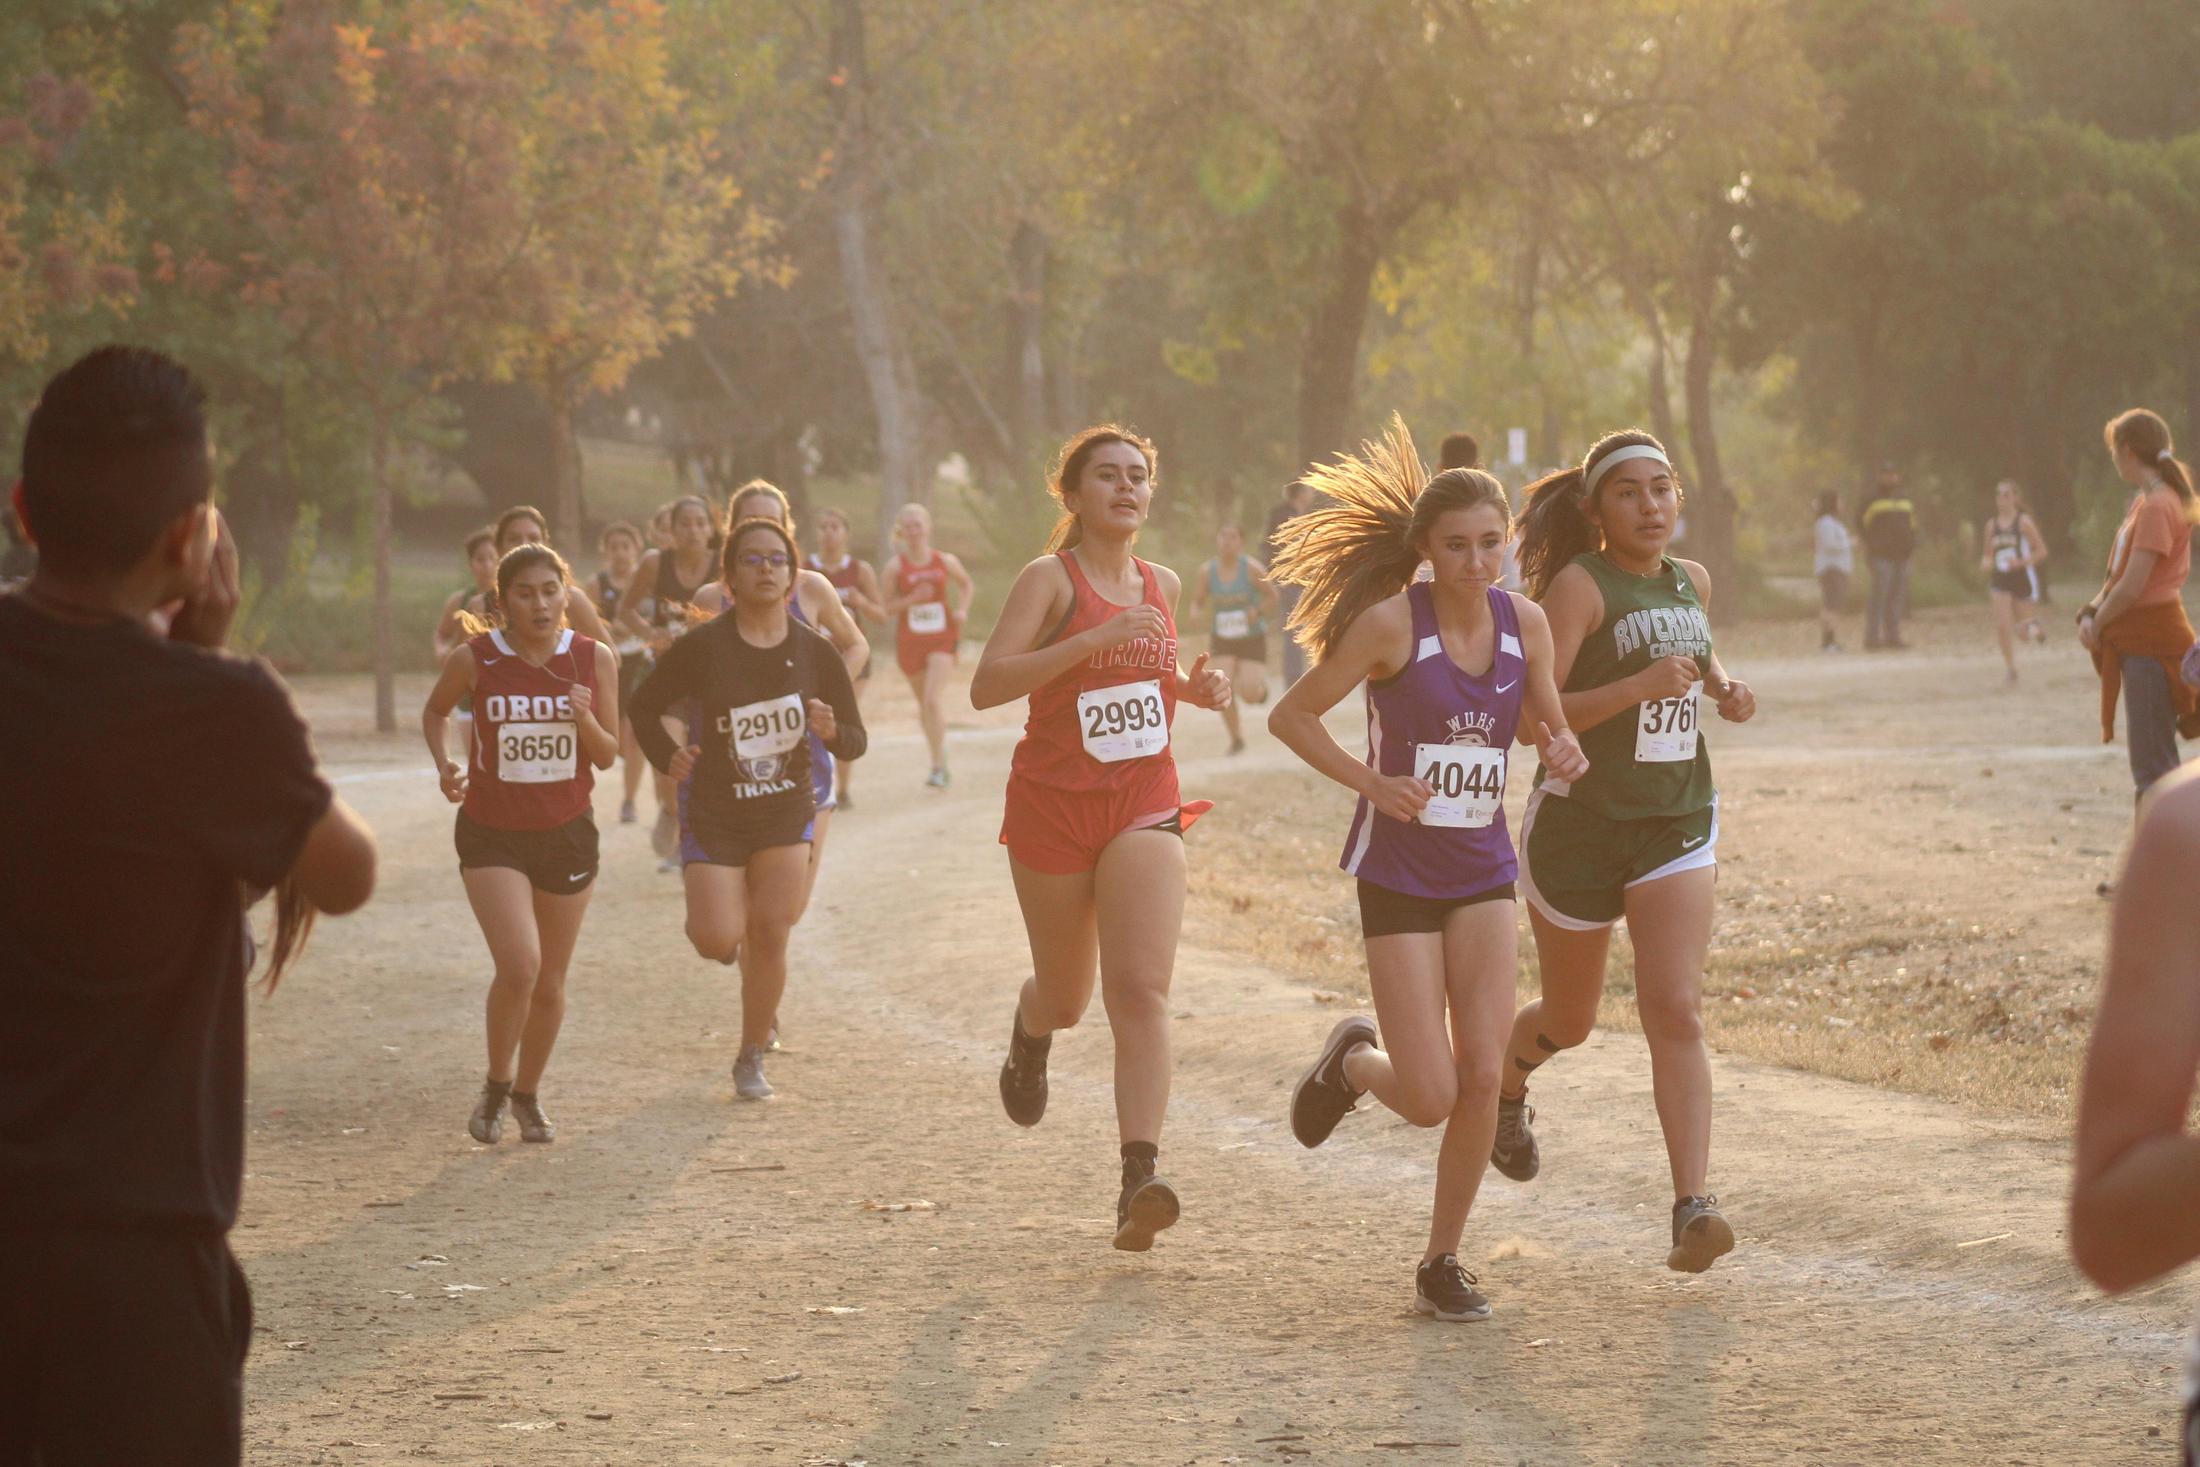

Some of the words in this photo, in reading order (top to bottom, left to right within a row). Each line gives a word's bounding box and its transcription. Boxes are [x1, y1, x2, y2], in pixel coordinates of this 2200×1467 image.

[1089, 637, 1177, 671] TRIBE
[1650, 641, 1706, 659] COWBOYS
[737, 706, 801, 741] 2910
[1085, 695, 1161, 738] 2993
[1446, 711, 1495, 733] WUHS
[1644, 696, 1697, 734] 3761
[503, 734, 572, 762] 3650
[1423, 760, 1500, 799] 4044
